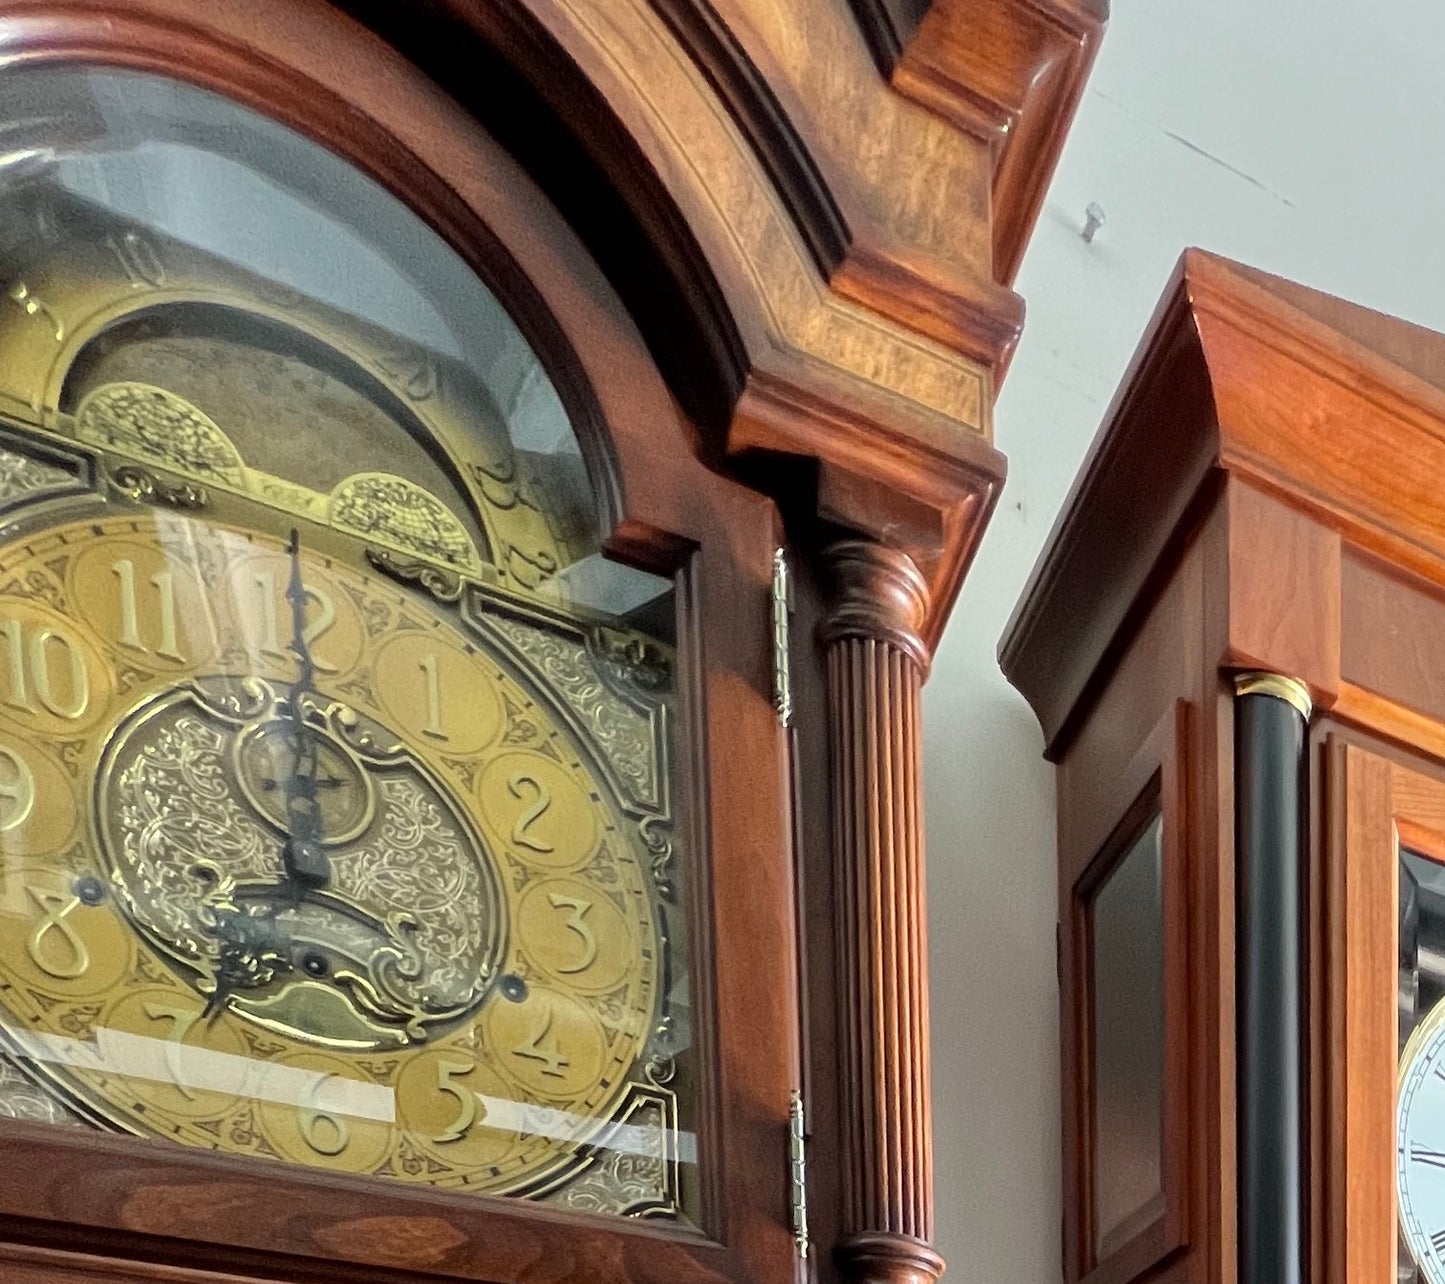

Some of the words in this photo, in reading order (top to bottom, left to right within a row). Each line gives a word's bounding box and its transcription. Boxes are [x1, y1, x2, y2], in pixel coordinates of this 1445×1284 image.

[110, 557, 188, 666] 11
[252, 570, 339, 675] 12
[0, 618, 90, 720] 10
[419, 653, 449, 742] 1
[507, 773, 555, 854] 2
[25, 884, 91, 980] 8
[546, 892, 598, 975] 3
[142, 1002, 206, 1103] 7
[510, 1003, 570, 1080] 4
[302, 1072, 351, 1157] 6
[430, 1059, 476, 1144] 5
